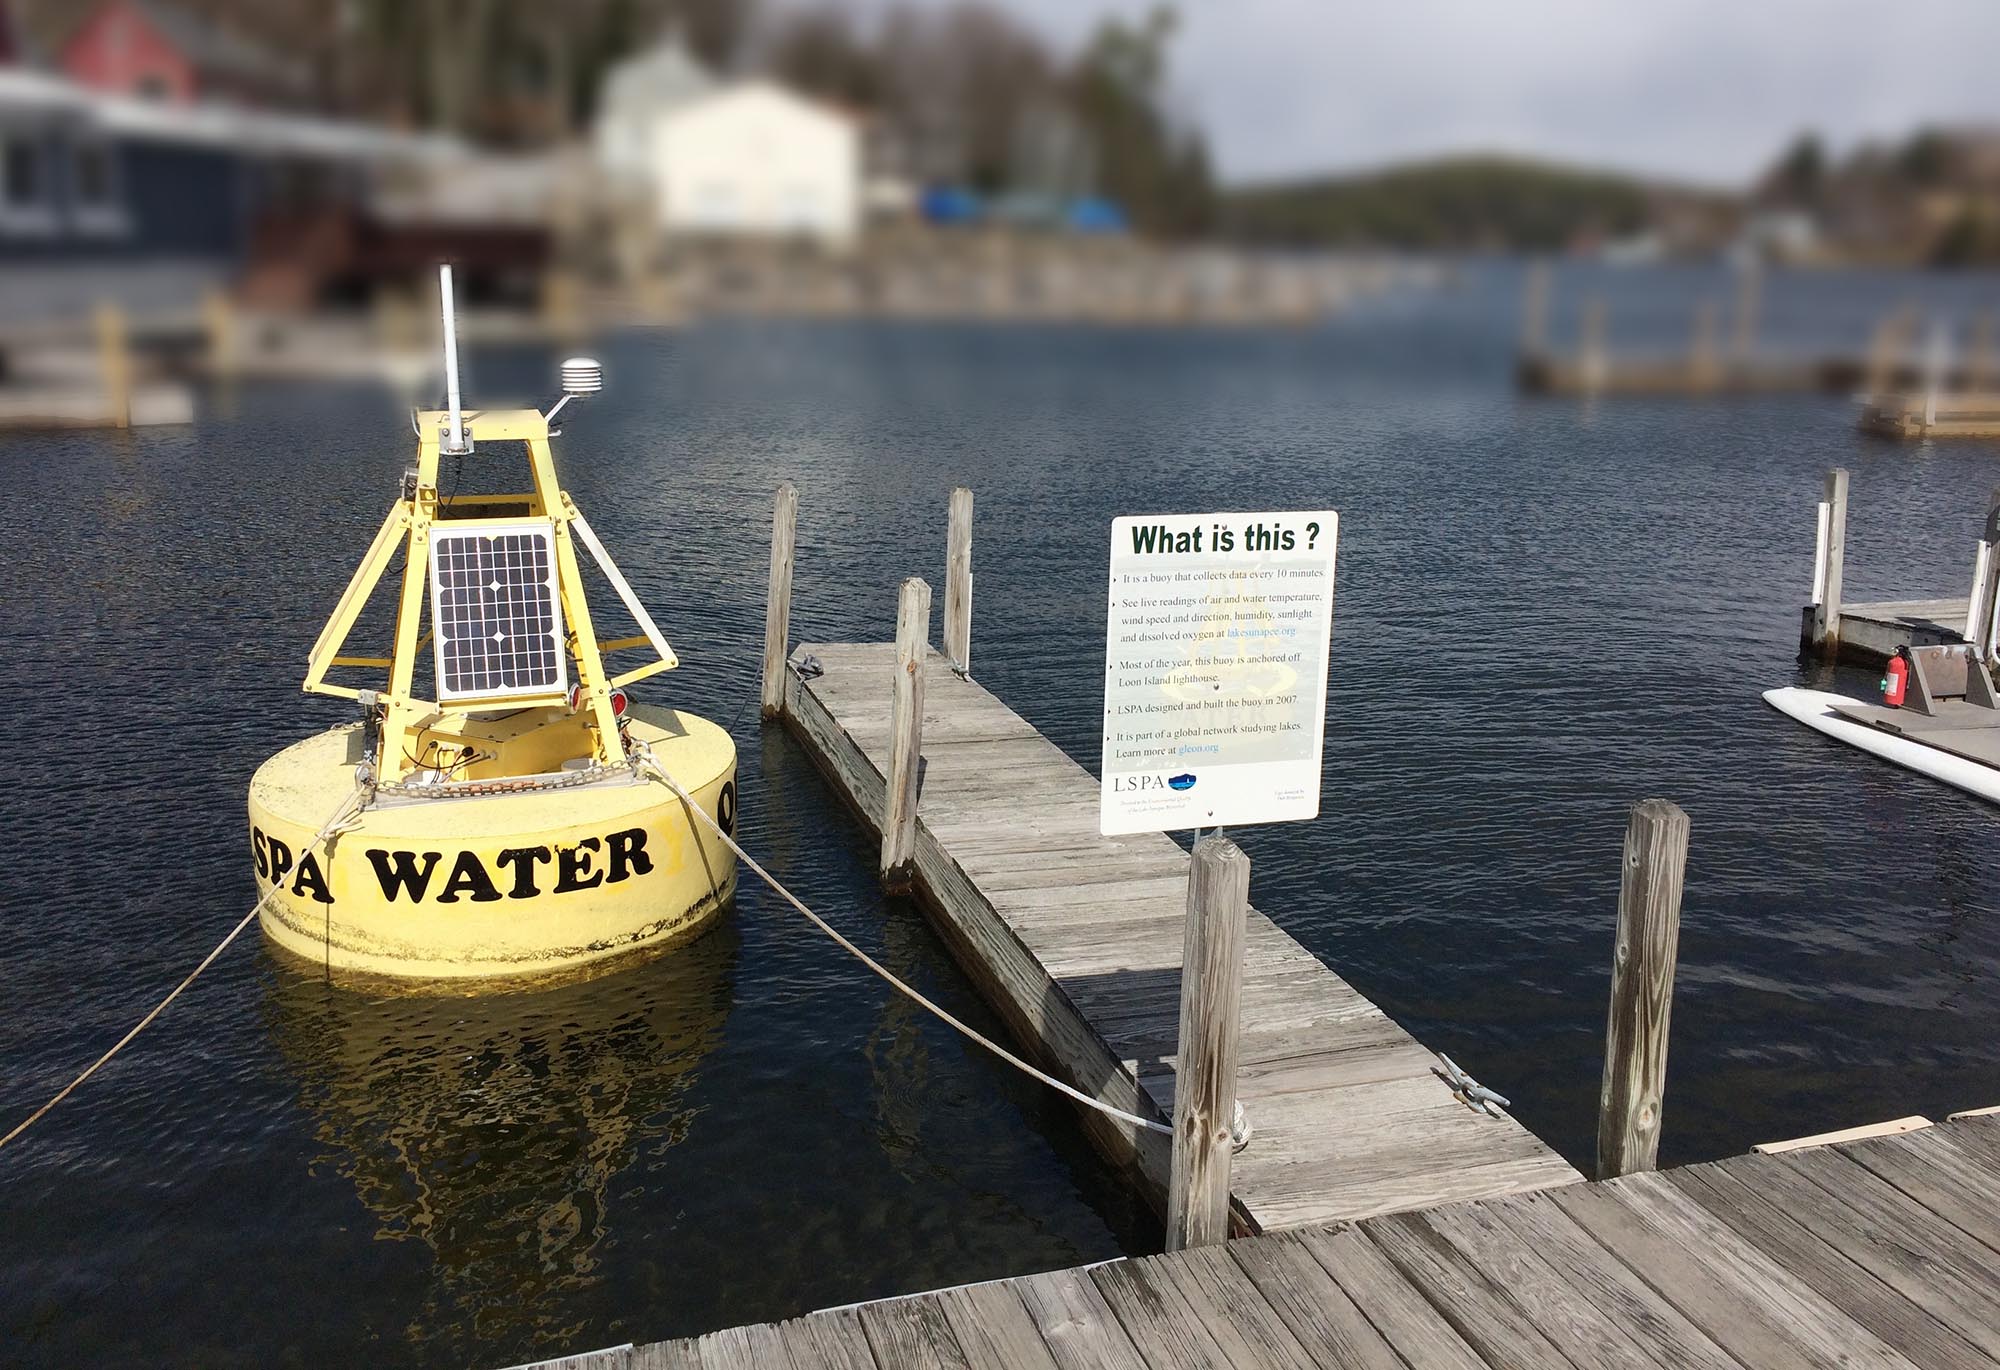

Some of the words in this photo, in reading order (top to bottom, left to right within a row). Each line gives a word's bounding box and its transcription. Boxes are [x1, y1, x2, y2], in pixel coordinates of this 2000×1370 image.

[1132, 525, 1202, 553] What
[1212, 524, 1234, 552] is
[1245, 523, 1295, 550] this
[1306, 522, 1320, 549] ?
[1124, 574, 1130, 583] It
[1133, 574, 1140, 582] is
[1151, 573, 1171, 584] buoy
[1175, 572, 1191, 581] that
[1193, 571, 1226, 580] collects
[1229, 570, 1247, 579] data
[1249, 571, 1274, 580] every
[1277, 569, 1287, 578] 10
[1122, 599, 1138, 608] See
[1141, 597, 1157, 607] live
[1160, 596, 1196, 608] readings
[1199, 595, 1208, 604] of
[1210, 595, 1222, 604] air
[1224, 594, 1240, 603] and
[1242, 594, 1266, 603] water
[1121, 615, 1143, 625] wind
[1145, 614, 1171, 626] speed
[1173, 613, 1189, 623] and
[1234, 611, 1275, 622] humidity,
[1277, 610, 1312, 620] sunlight
[1120, 632, 1136, 642] and
[1139, 631, 1180, 642] dissolved
[1182, 632, 1214, 641] oxygen
[1227, 628, 1296, 638] lakesunapee.org
[1120, 660, 1142, 670] Most
[1144, 659, 1155, 669] of
[1156, 659, 1169, 668] the
[1195, 657, 1211, 666] this
[1213, 655, 1234, 666] buoy
[1237, 655, 1245, 663] is
[1247, 653, 1286, 663] anchored
[1288, 653, 1301, 662] off
[1119, 678, 1141, 687] Loon
[1144, 676, 1170, 685] Island
[1118, 706, 1142, 715] LSPA
[1145, 702, 1184, 714] designed
[1186, 701, 1201, 710] and
[1204, 699, 1223, 708] built
[1226, 699, 1239, 707] the
[1241, 698, 1262, 708] buoy
[1266, 697, 1273, 705] in
[1116, 732, 1124, 741] It
[1127, 732, 1133, 741] is
[1135, 731, 1153, 742] part
[1155, 730, 1166, 739] of
[1174, 728, 1201, 739] global
[1203, 726, 1238, 735] network
[1241, 724, 1277, 735] studying
[1116, 748, 1141, 758] Learn
[1144, 748, 1166, 756] more
[1179, 743, 1219, 756] gleon.org
[1113, 775, 1164, 792] LSPA
[365, 827, 655, 904] WATER
